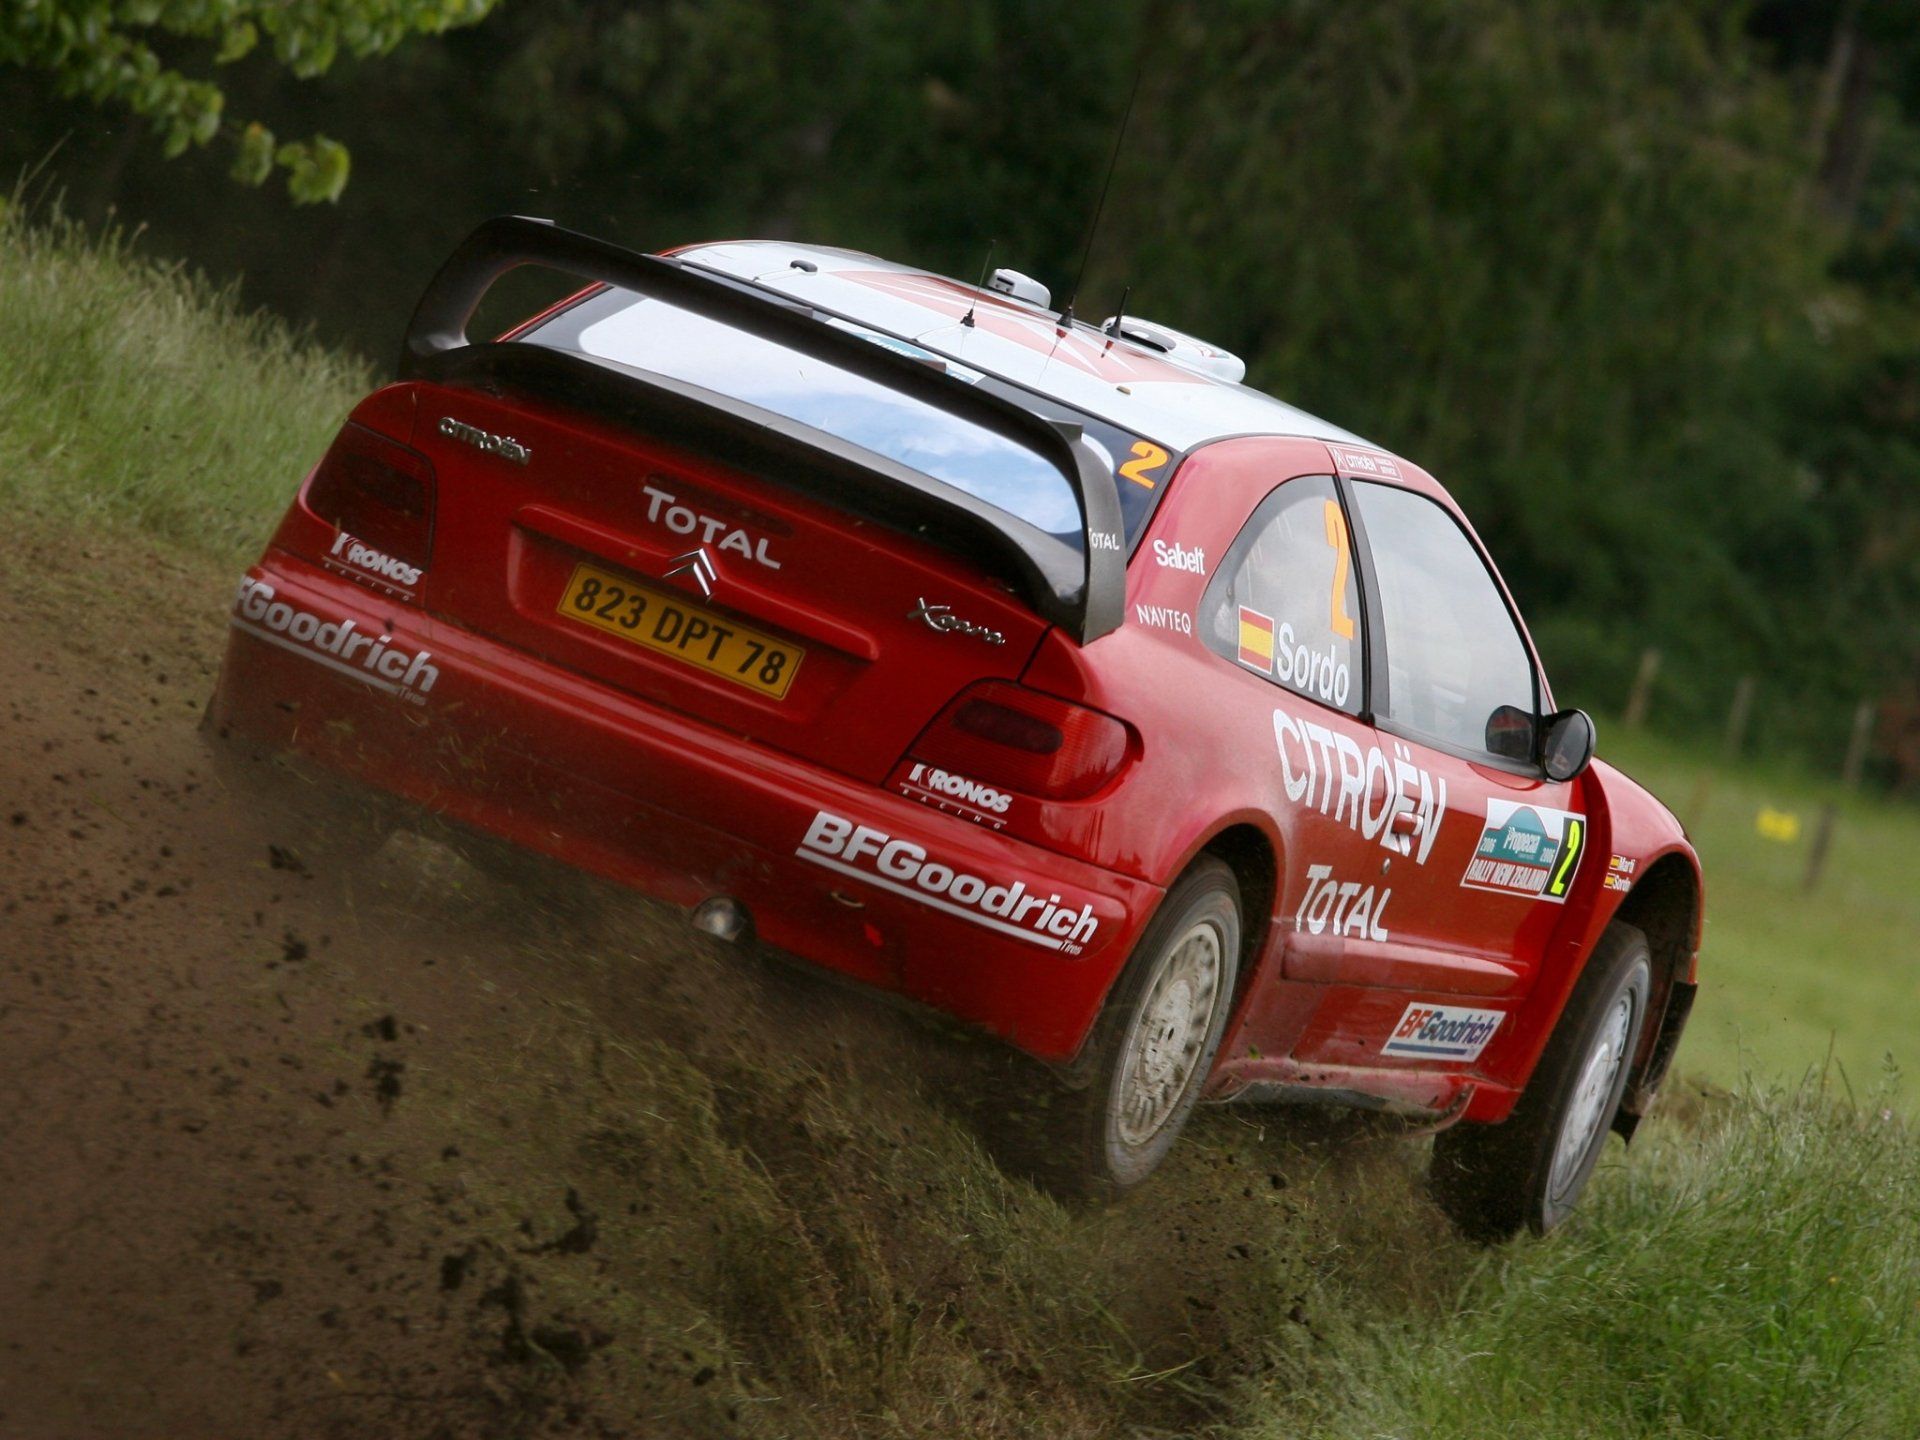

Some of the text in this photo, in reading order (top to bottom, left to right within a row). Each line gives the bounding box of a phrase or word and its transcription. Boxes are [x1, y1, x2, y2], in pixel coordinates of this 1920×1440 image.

[1118, 441, 1168, 489] 2
[330, 532, 423, 585] KRONOS
[643, 485, 781, 570] TOTAL
[1153, 539, 1205, 575] Sabelt
[1323, 499, 1354, 640] 2
[574, 577, 787, 687] 823 DPT 78
[1136, 604, 1191, 638] NAVTEQ
[1276, 622, 1349, 707] Sordo
[909, 763, 1013, 813] KRONOS
[1273, 709, 1446, 865] CITROËN
[802, 811, 1098, 943] BFGoodrich
[1490, 862, 1516, 886] NEW
[1509, 865, 1548, 892] ZEALAND
[1550, 820, 1580, 895] 2
[1296, 864, 1391, 942] TOTAL
[1060, 939, 1083, 955] Tires
[1395, 1009, 1494, 1045] BFGoodrich
